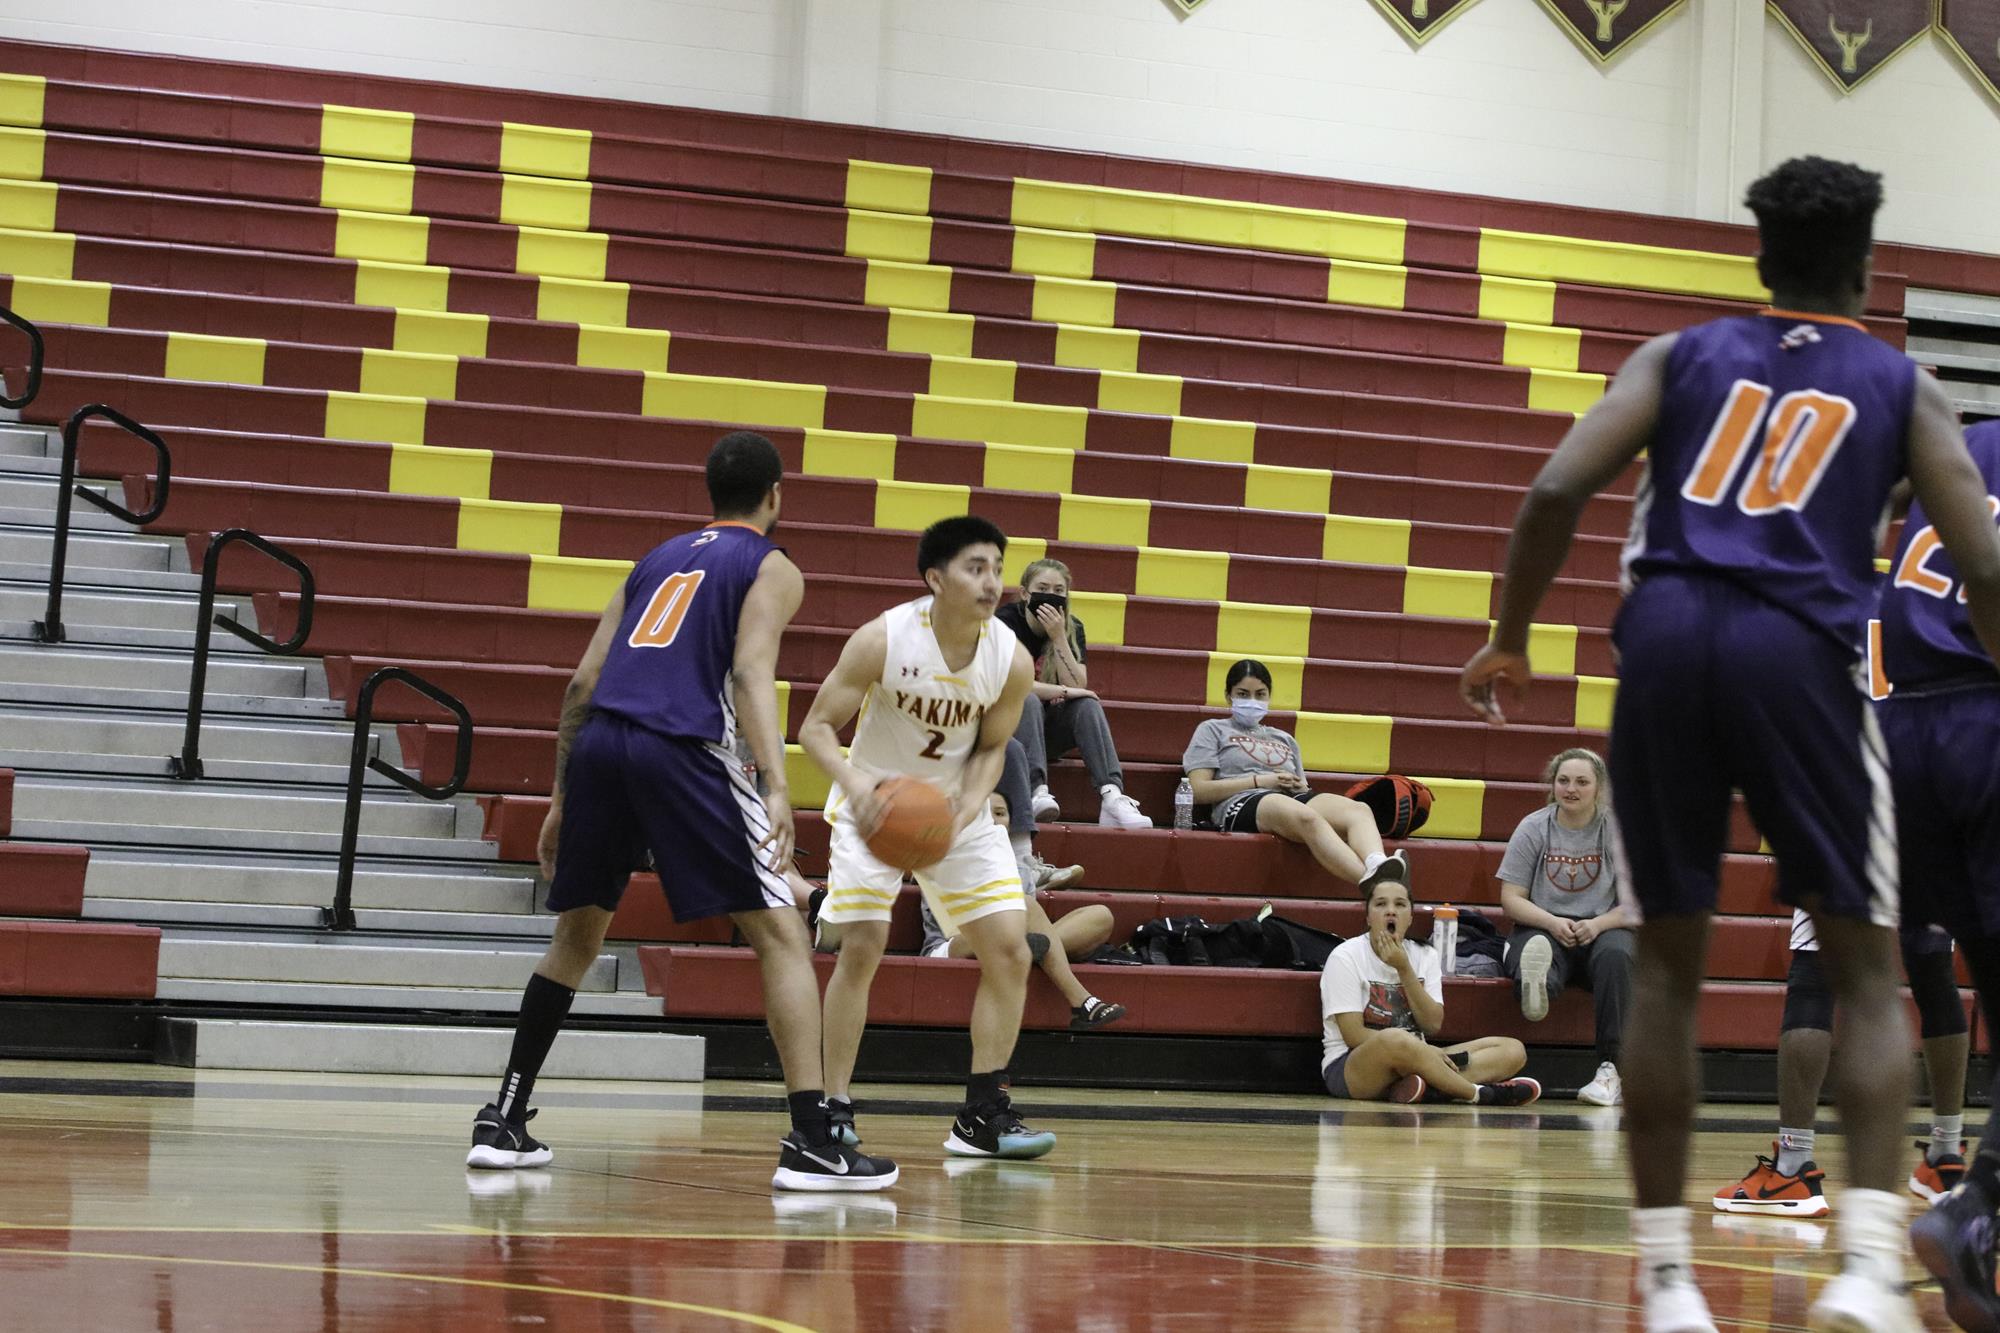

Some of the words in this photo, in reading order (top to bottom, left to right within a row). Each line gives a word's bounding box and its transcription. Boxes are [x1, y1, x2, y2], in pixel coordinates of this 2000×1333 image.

[1681, 379, 1857, 516] 10
[628, 569, 706, 648] 0
[919, 729, 945, 761] 2
